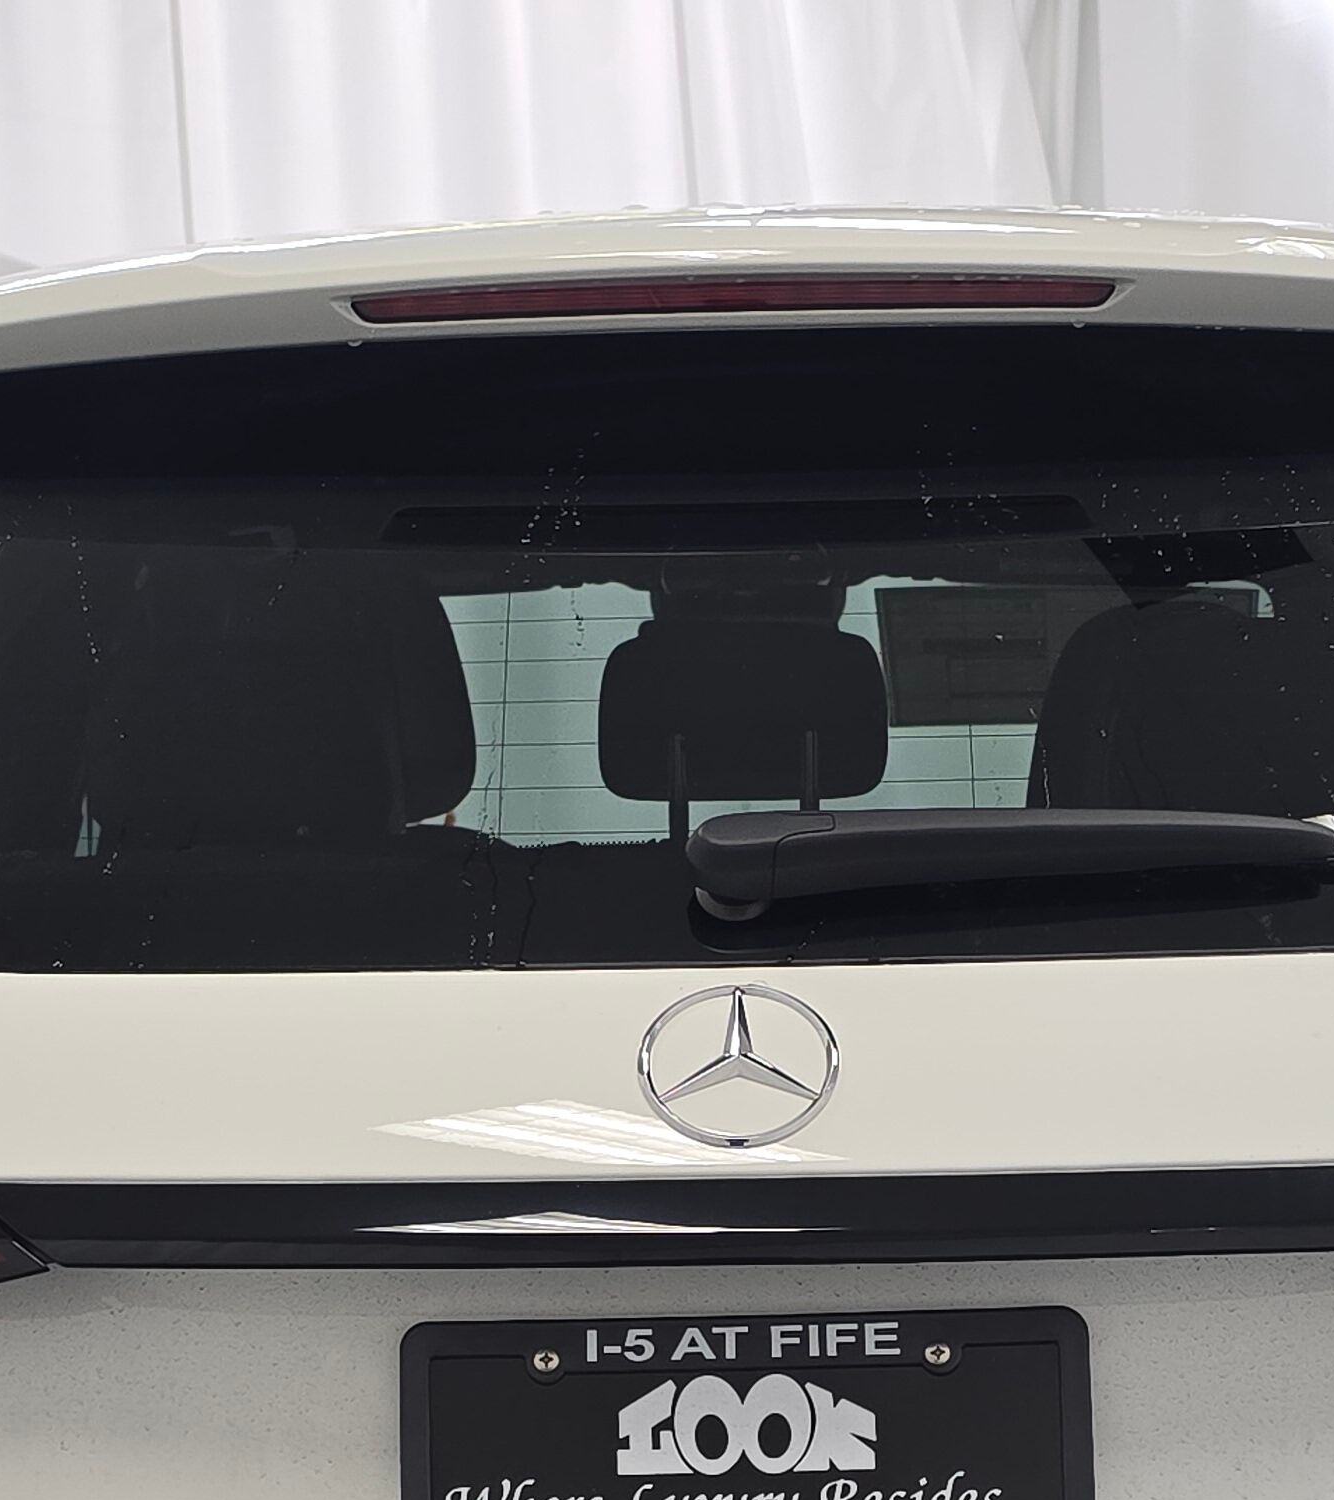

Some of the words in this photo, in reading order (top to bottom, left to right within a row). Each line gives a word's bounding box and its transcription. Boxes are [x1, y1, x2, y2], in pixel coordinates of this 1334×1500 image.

[586, 1328, 655, 1363] I-5
[672, 1326, 750, 1360] AT
[771, 1322, 902, 1359] FIFE
[616, 1373, 876, 1476] LOOK
